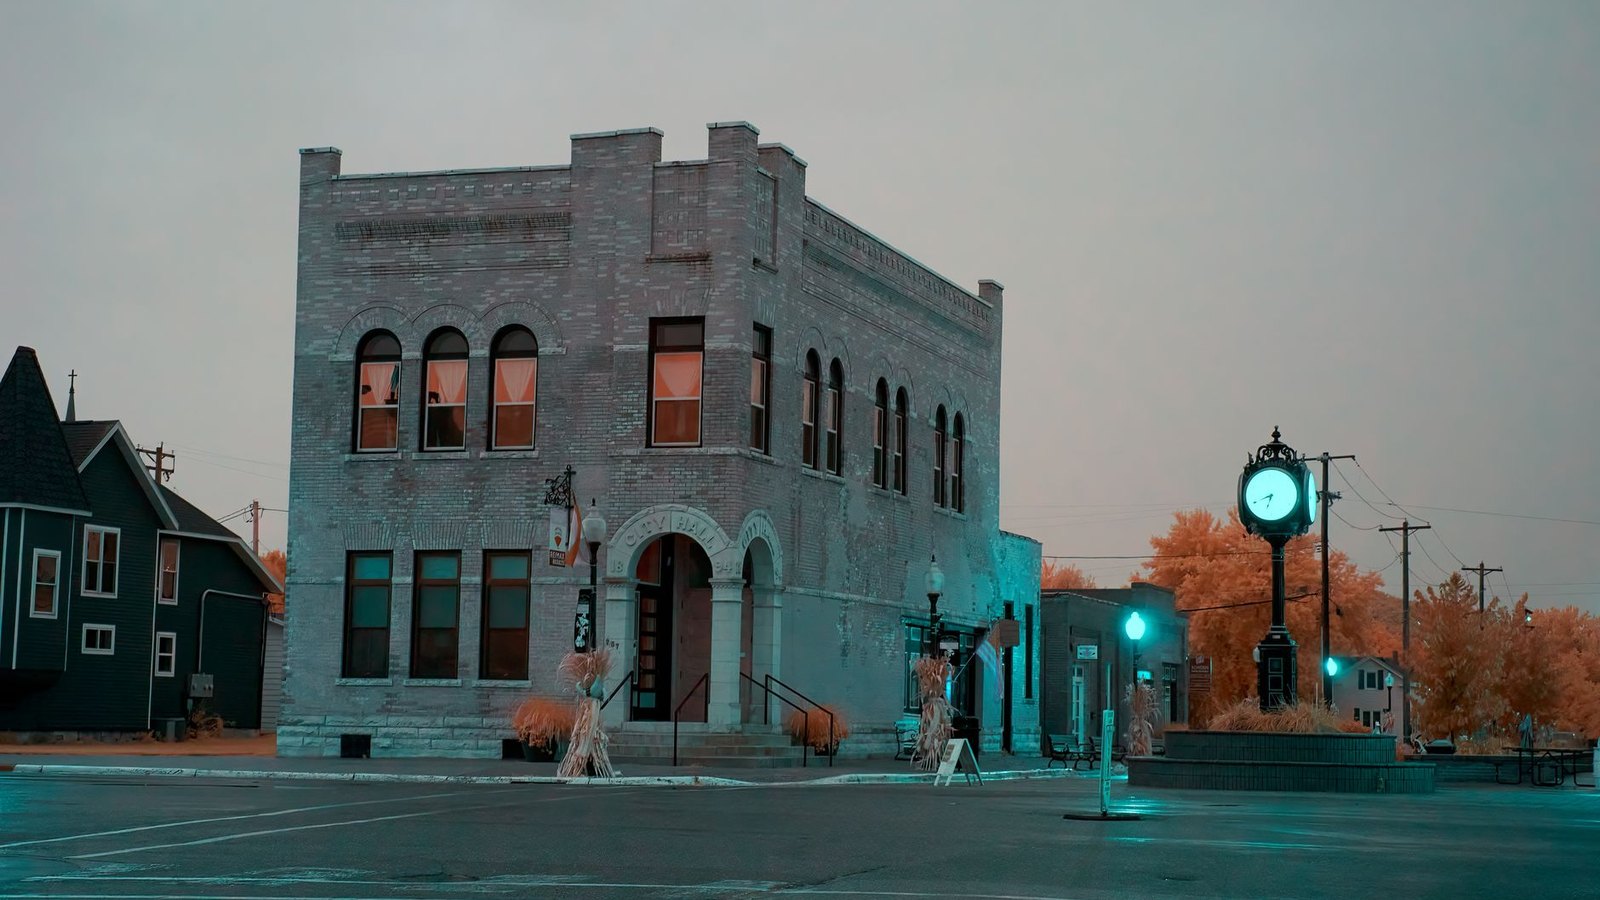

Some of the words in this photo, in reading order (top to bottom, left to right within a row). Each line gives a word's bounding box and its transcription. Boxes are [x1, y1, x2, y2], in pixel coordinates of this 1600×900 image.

[625, 515, 665, 546] CITY
[677, 516, 716, 550] HALL
[611, 559, 624, 573] 18
[715, 561, 733, 573] 94
